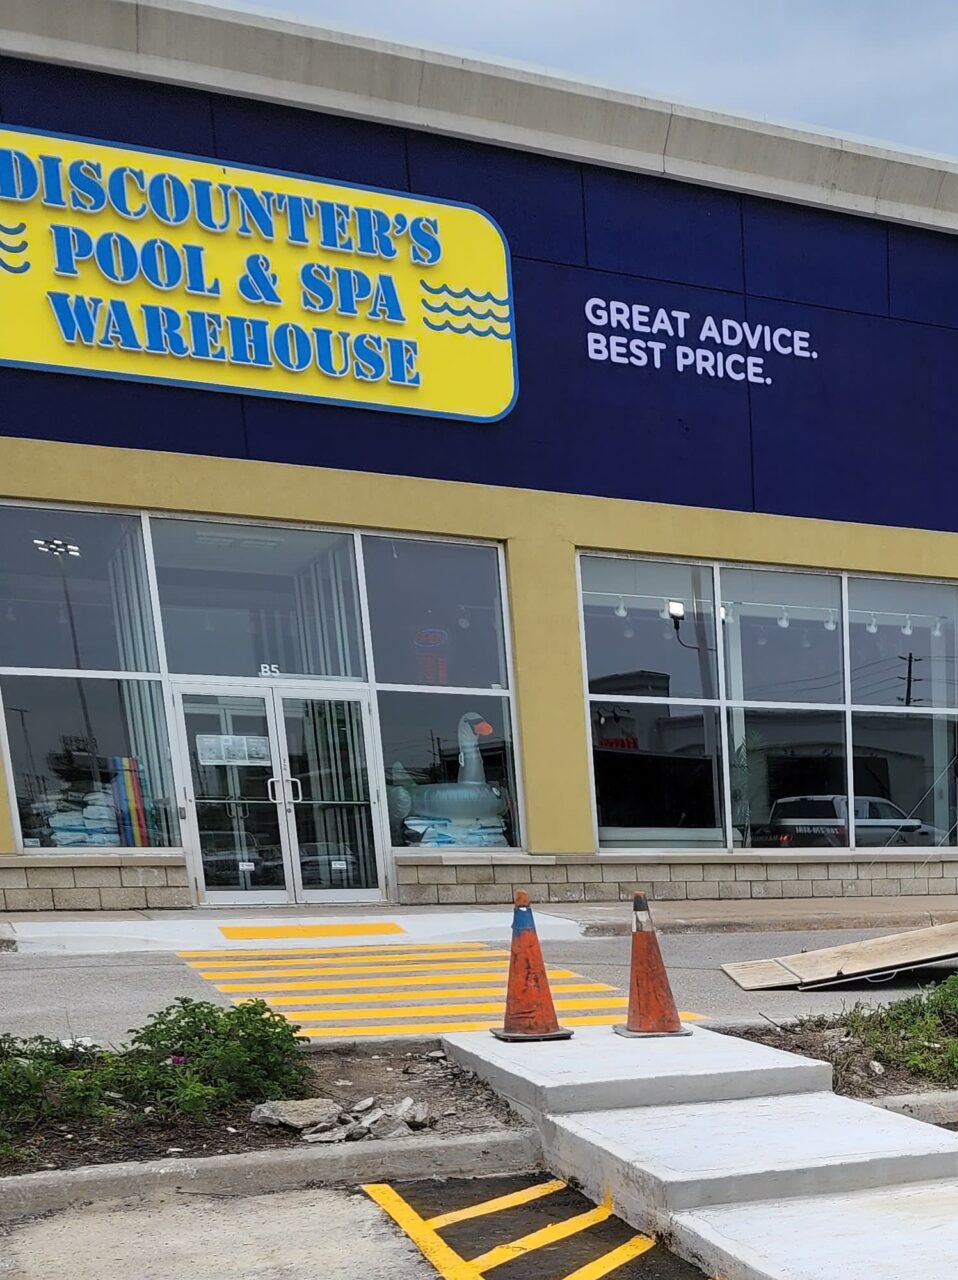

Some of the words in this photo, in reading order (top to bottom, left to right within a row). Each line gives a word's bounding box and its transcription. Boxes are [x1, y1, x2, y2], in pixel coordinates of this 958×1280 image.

[0, 147, 442, 266] DISCOUNTER'S
[50, 223, 220, 297] POOL
[237, 253, 282, 306] &
[300, 262, 406, 322] SPA
[46, 290, 422, 388] WAREHOUSE
[585, 297, 690, 338] GREAT
[699, 315, 818, 359] ADVICE.
[587, 332, 667, 369] BEST
[676, 345, 772, 385] PRICE.
[260, 663, 280, 677] B5
